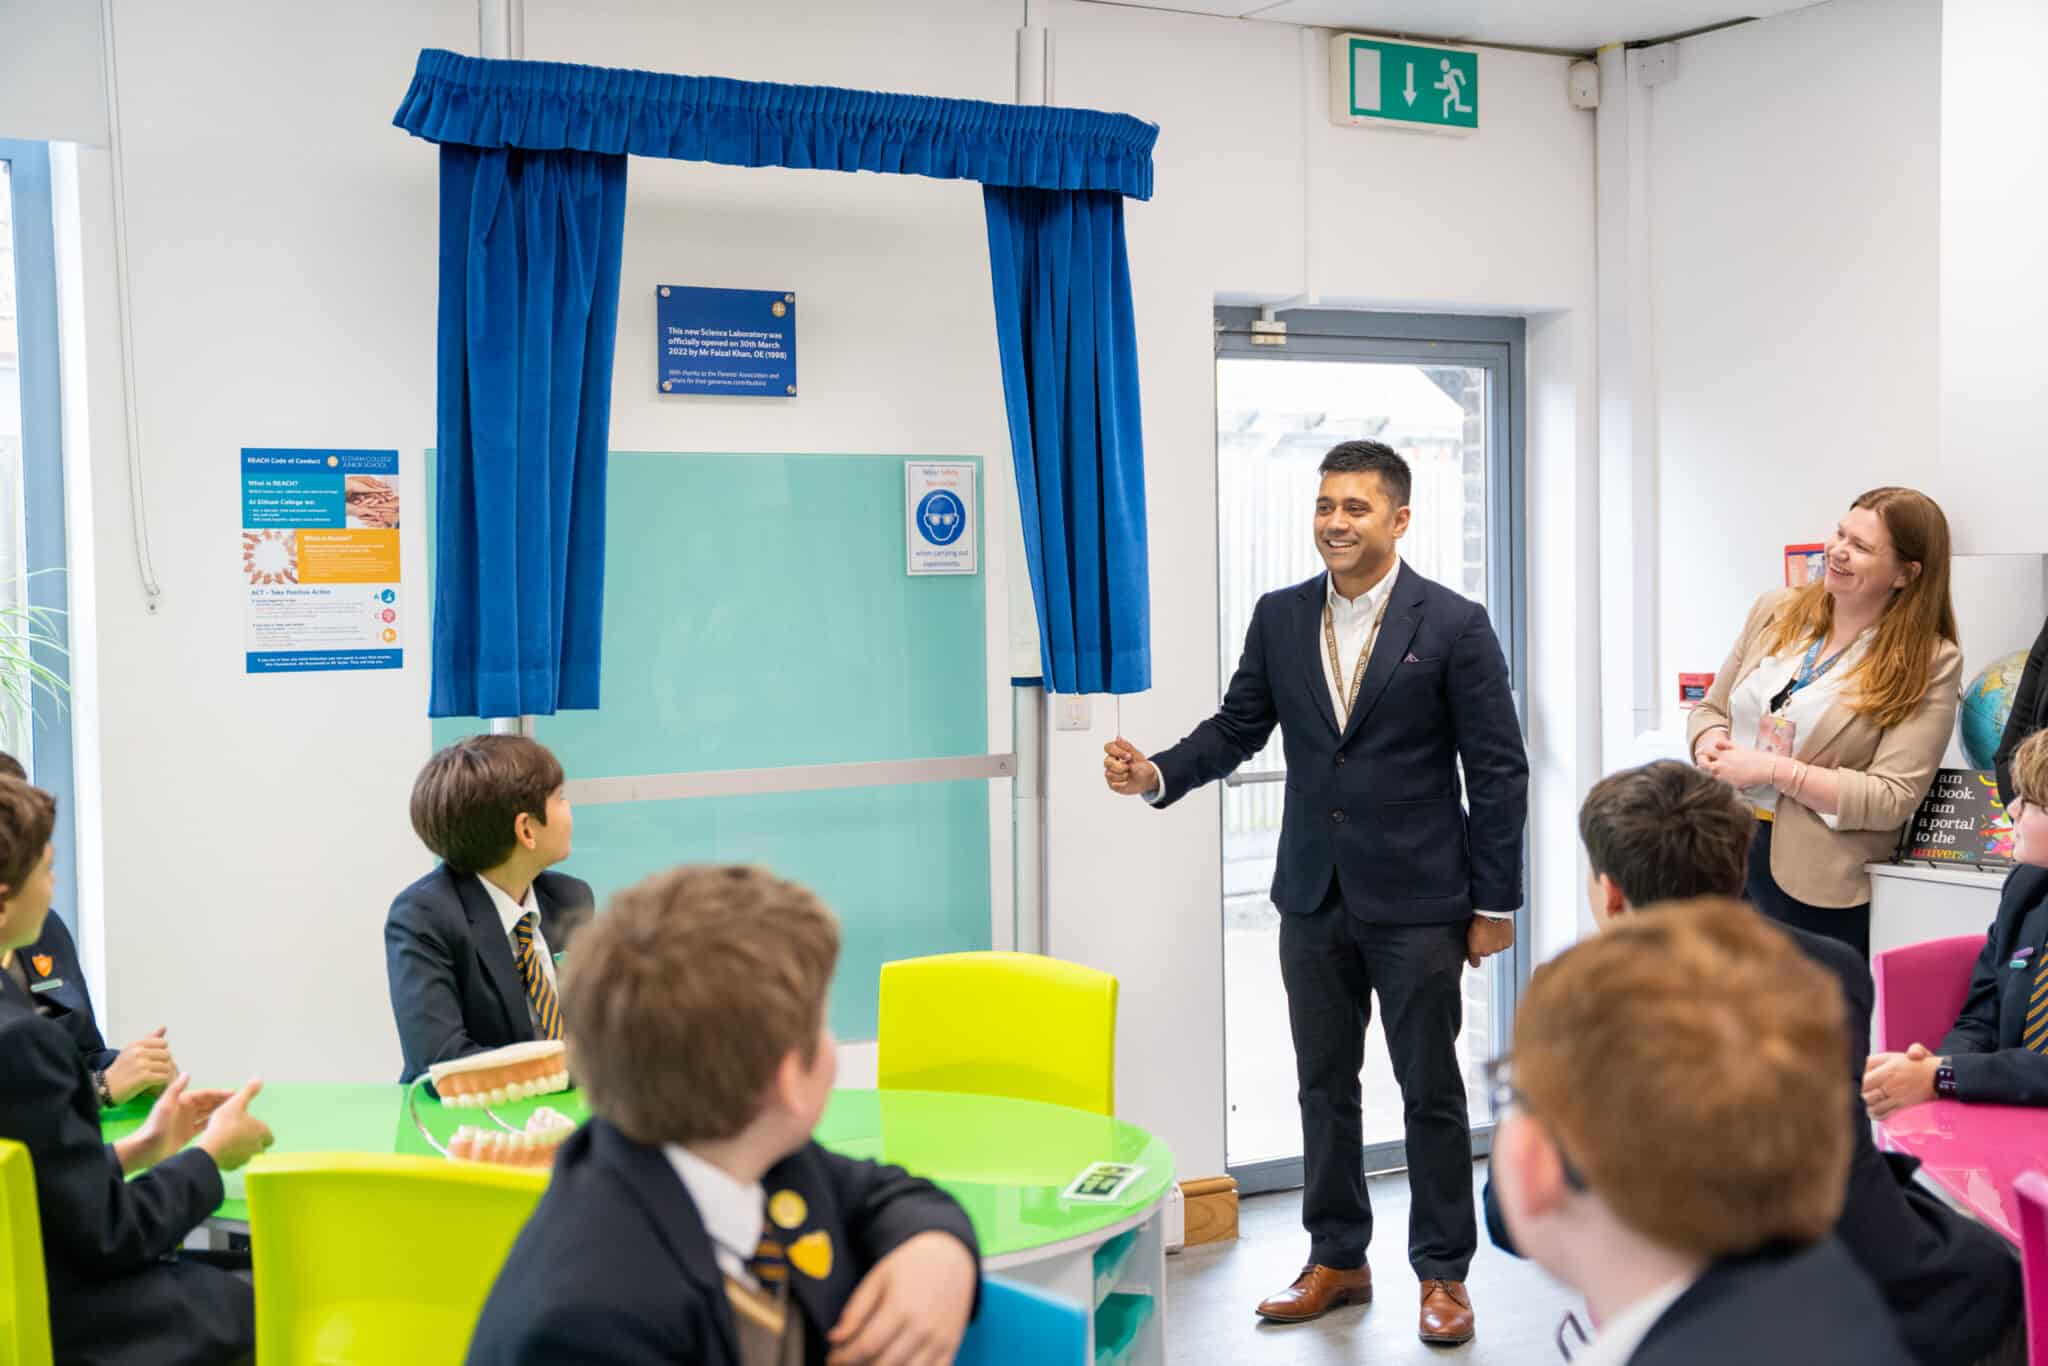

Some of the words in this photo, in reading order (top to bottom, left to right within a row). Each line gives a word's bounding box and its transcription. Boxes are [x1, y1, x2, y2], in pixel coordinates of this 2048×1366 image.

[668, 326, 683, 336] This
[701, 328, 728, 337] Science
[729, 330, 768, 340] Laboratory
[668, 337, 699, 348] officially
[701, 338, 728, 348] opened
[729, 340, 739, 348] on
[740, 340, 757, 349] 30th
[758, 341, 780, 349] March
[668, 347, 688, 356] 2022
[689, 347, 698, 358] by
[710, 348, 731, 357] Faizal
[754, 350, 765, 359] OE
[247, 457, 270, 465] REACH
[271, 457, 287, 465] Code
[1939, 774, 1962, 784] am
[1938, 785, 1976, 800] book.
[1923, 801, 1929, 812] I
[1931, 803, 1955, 814] am
[1918, 817, 1928, 827] a
[1928, 817, 1975, 831] portal
[1916, 831, 1930, 842] to
[1932, 830, 1956, 844] the
